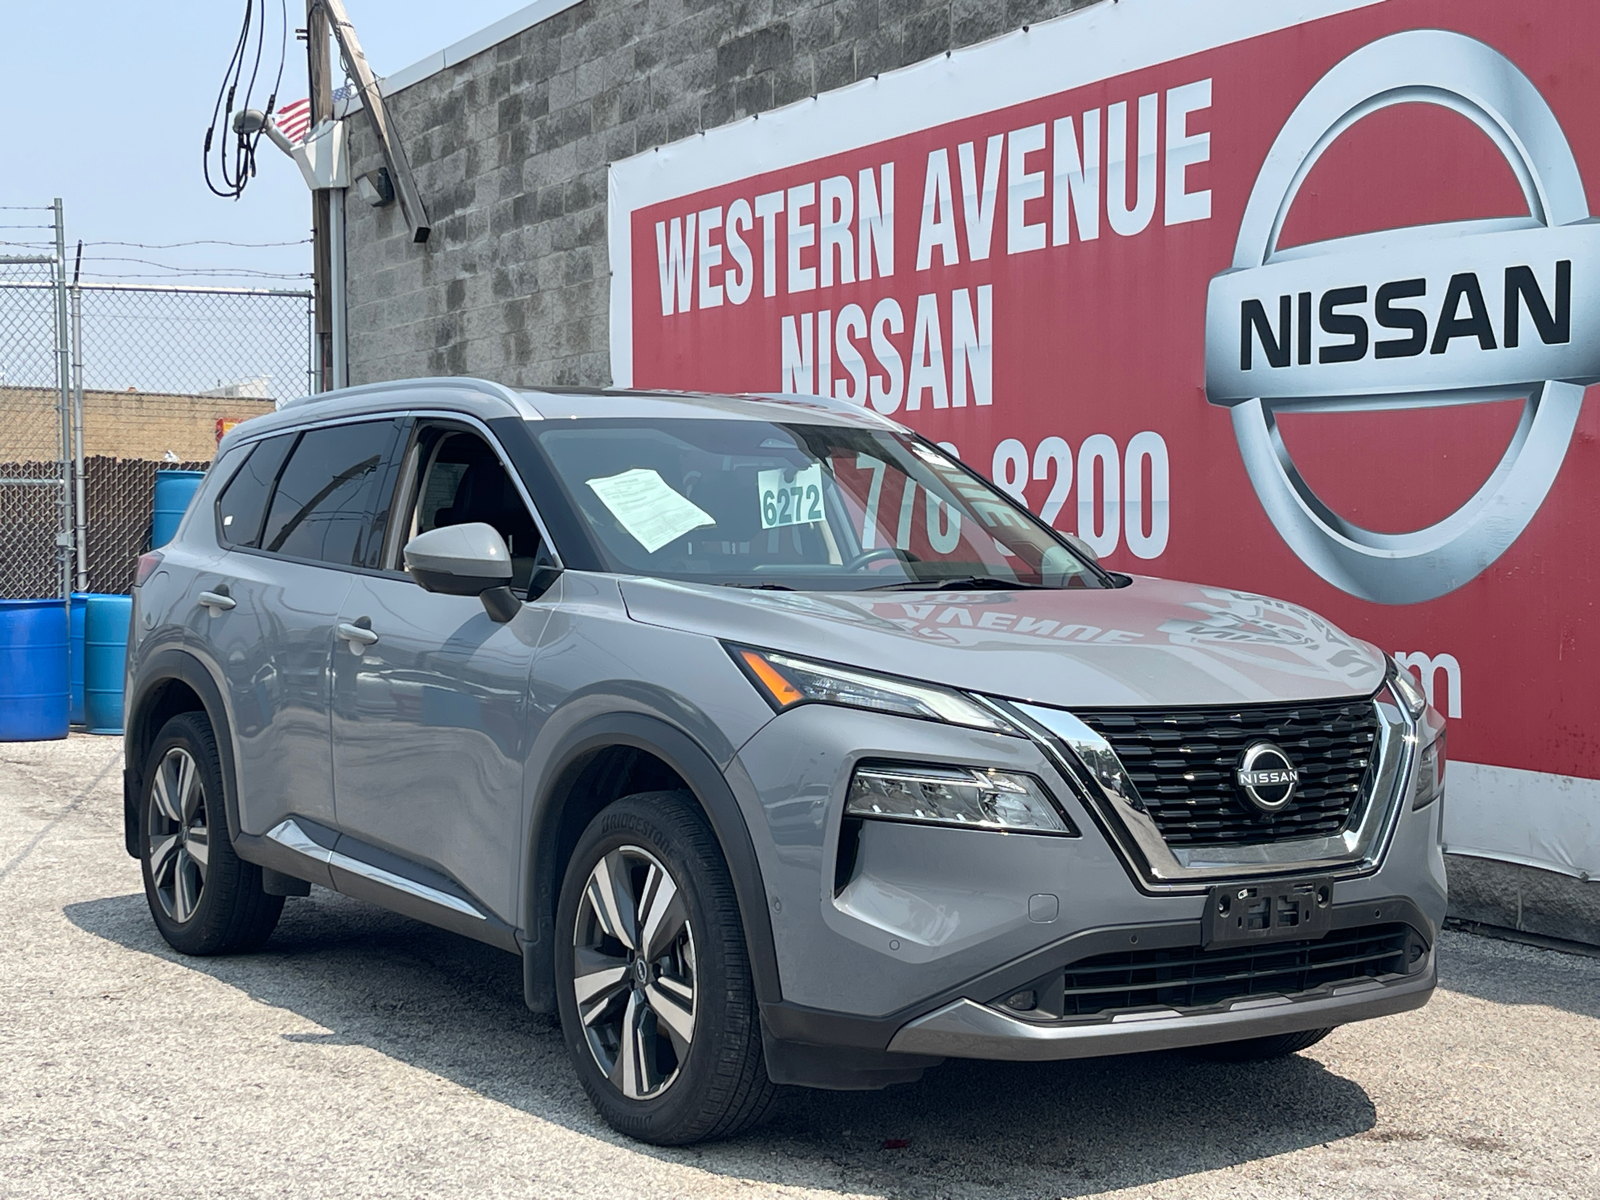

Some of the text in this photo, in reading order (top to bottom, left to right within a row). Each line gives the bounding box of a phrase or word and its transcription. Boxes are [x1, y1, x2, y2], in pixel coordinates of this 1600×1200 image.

[655, 78, 1212, 316] WESTERN AVENUE
[782, 284, 993, 415] NISSAN
[1240, 259, 1571, 371] NISSAN
[763, 484, 822, 527] 6272
[992, 431, 1169, 559] 8200
[1240, 770, 1297, 784] NISSAN
